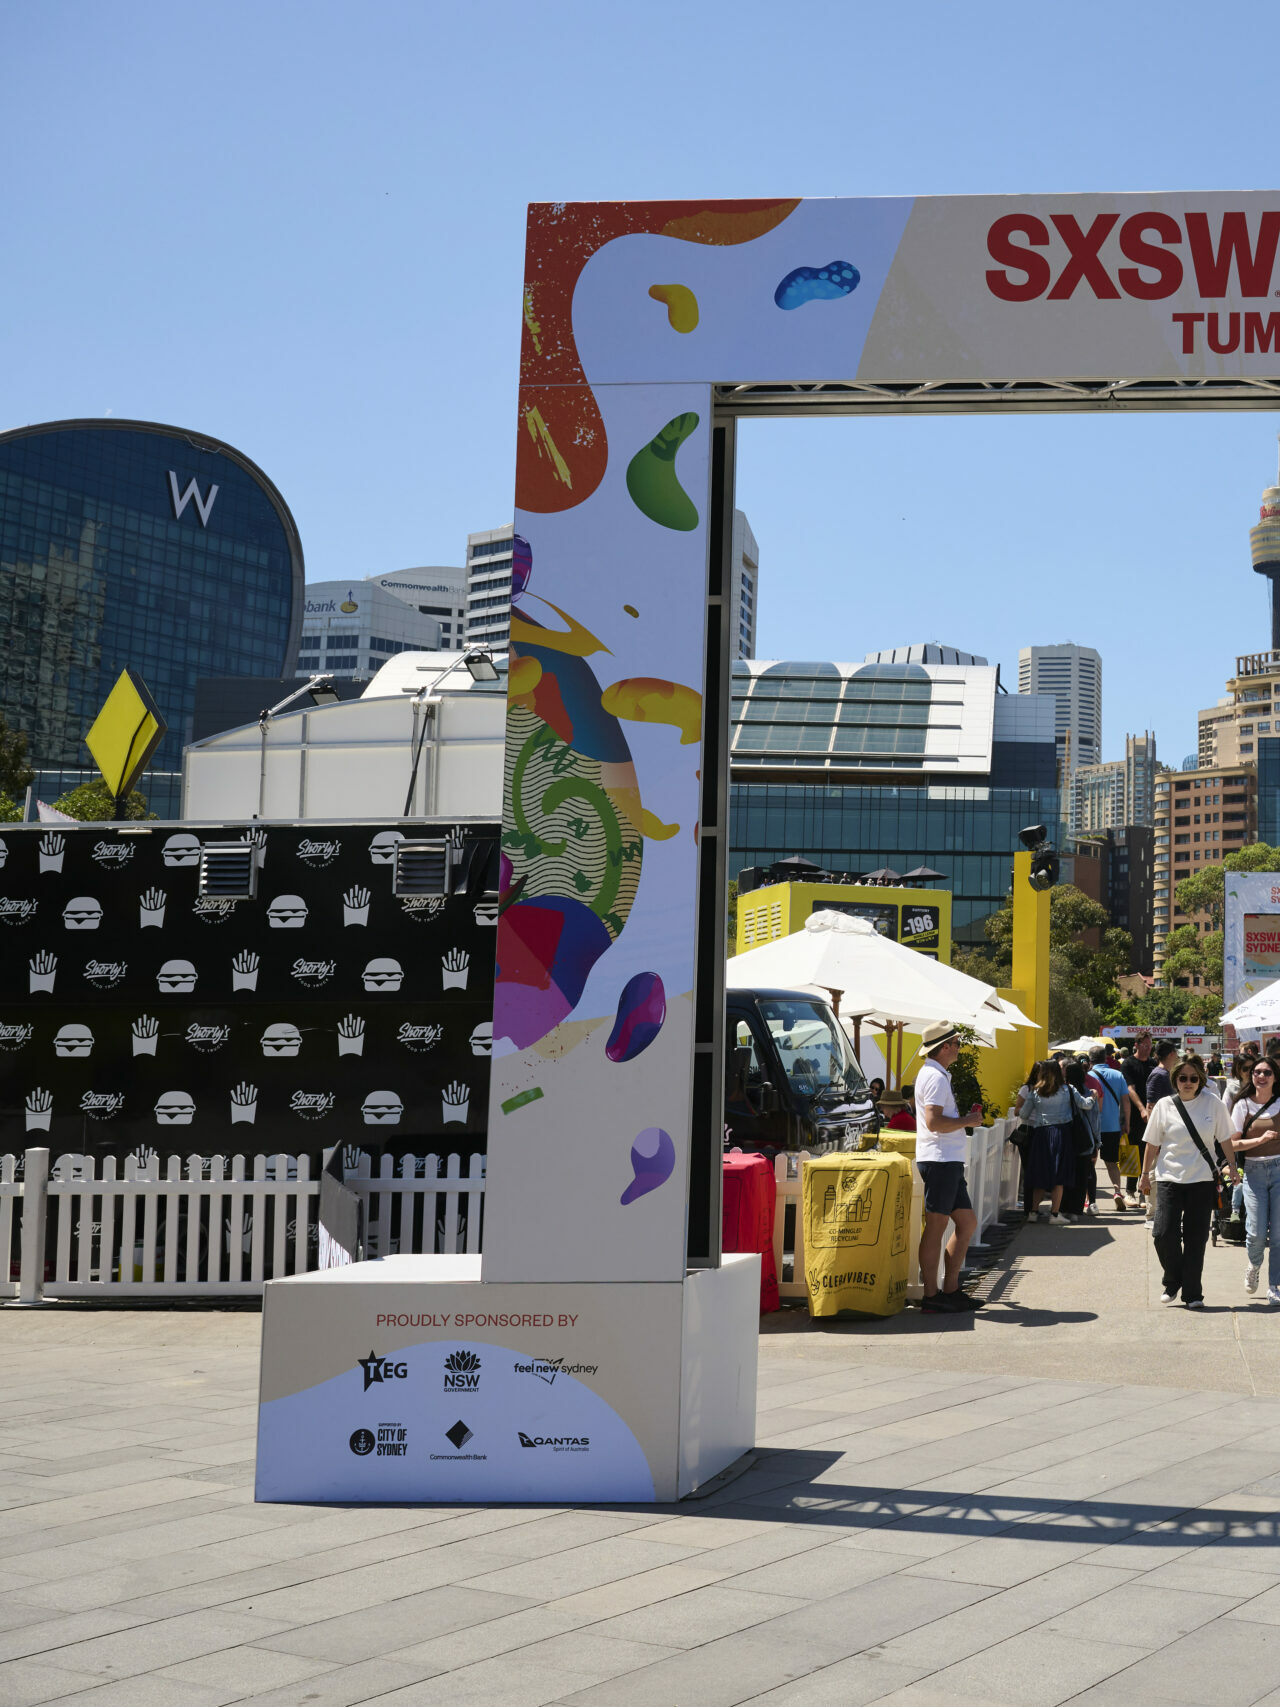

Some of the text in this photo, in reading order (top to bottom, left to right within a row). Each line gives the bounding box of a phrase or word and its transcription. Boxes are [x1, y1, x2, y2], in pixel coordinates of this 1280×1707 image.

[166, 469, 220, 529] W
[92, 841, 136, 861] Shorty's
[296, 839, 341, 860] Shorty's
[192, 897, 236, 915] Shorty's
[402, 897, 447, 912] Shorty's
[1246, 932, 1277, 942] SXSW
[83, 960, 127, 979] Shorty's
[291, 959, 336, 978] Shorty's
[0, 1022, 33, 1043] horty's
[185, 1023, 230, 1043] Shorty's
[397, 1023, 443, 1043] Shorty's
[1152, 1026, 1178, 1034] SYDNEY
[80, 1091, 124, 1111] Shorty's
[290, 1090, 335, 1111] Shorty's
[376, 1313, 579, 1327] PROUDLY SPONSORED BY
[514, 1362, 599, 1375] feel new sydney
[444, 1374, 480, 1388] NSW
[377, 1428, 408, 1442] CITY OF
[533, 1437, 590, 1446] QANTAS
[376, 1443, 408, 1456] SYDNEY
